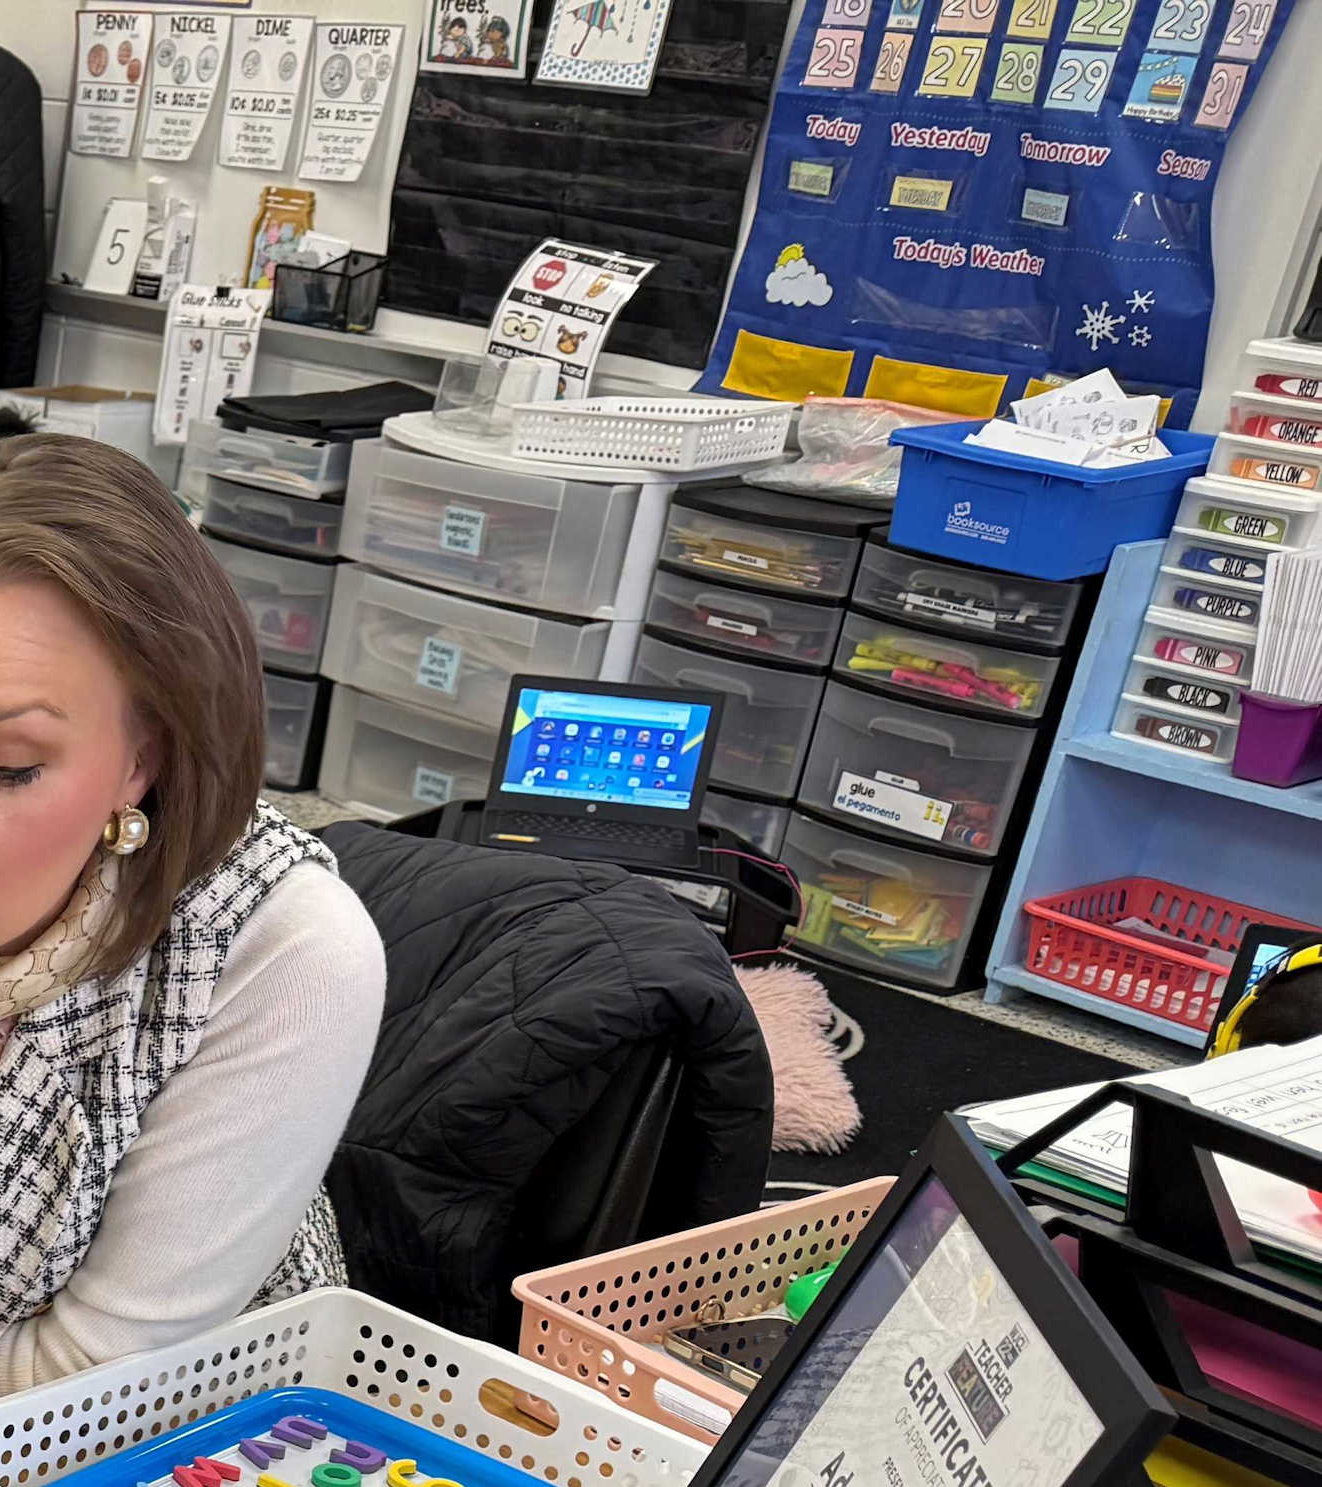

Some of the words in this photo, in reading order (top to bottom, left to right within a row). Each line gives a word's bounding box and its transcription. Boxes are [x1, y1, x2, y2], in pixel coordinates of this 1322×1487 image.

[96, 14, 139, 31] PENNY
[171, 16, 216, 34] NICKEL
[256, 19, 292, 37] DIME
[1071, 0, 1132, 36] 22
[1154, 0, 1209, 42] 23
[1224, 1, 1271, 46] 24
[328, 28, 391, 46] QUARTER
[808, 37, 857, 78] 25
[875, 40, 906, 82] 26
[924, 46, 983, 87] 27
[996, 52, 1039, 92] 28
[1050, 58, 1109, 102] 29
[1202, 70, 1243, 115] 31
[807, 116, 861, 145] Today
[892, 123, 990, 156] Yesterday
[1021, 133, 1110, 166] Tomorrow
[1159, 150, 1211, 181] Season
[107, 229, 130, 265] 5
[555, 249, 578, 261] stop
[894, 237, 965, 268] Today's
[970, 245, 1045, 276] Weather
[536, 267, 563, 282] STOP
[522, 293, 544, 307] look
[573, 305, 604, 323] talking
[1299, 380, 1317, 397] RED
[1278, 421, 1320, 444] ORANGE
[1265, 463, 1305, 484] YELLOW
[947, 514, 1009, 536] booksource
[1234, 515, 1268, 538] GREEN
[1222, 557, 1248, 577] BLUE
[1206, 597, 1244, 617] PURPLE
[1193, 647, 1220, 668] PINK
[1179, 686, 1209, 706] BLACK
[1167, 725, 1202, 747] BROWN
[849, 782, 876, 798] glue
[837, 794, 845, 804] el
[846, 798, 901, 821] pegamento
[974, 1338, 1013, 1402] TEACHER
[895, 1407, 913, 1426] OF
